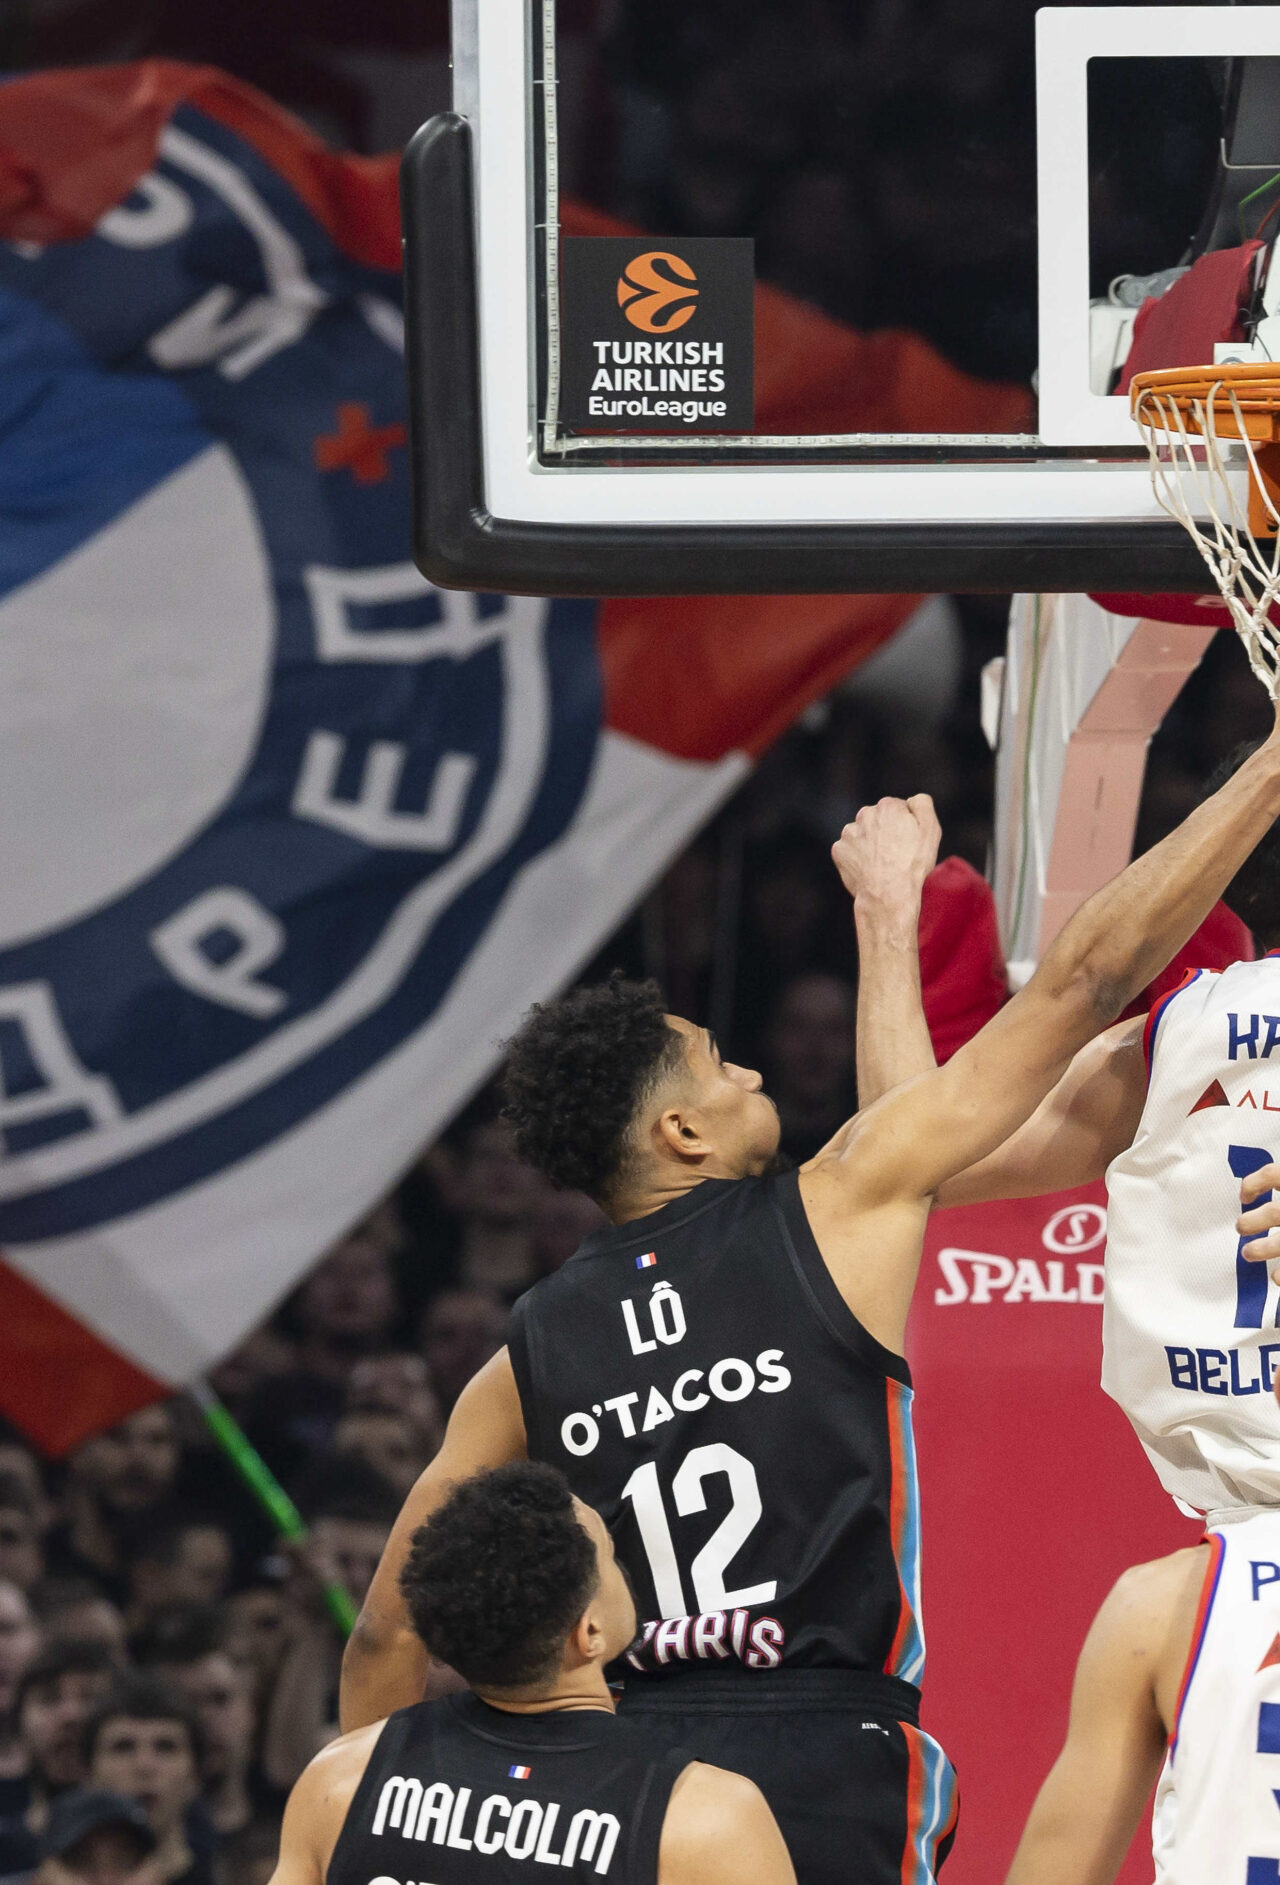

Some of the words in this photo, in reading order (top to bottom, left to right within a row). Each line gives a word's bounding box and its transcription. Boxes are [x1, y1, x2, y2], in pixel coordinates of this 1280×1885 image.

[591, 368, 725, 392] AIRLINES
[593, 341, 724, 365] TURKISH
[588, 396, 727, 422] EuroLeague
[621, 1281, 687, 1355] LÔ
[561, 1349, 791, 1456] O'TACOS
[621, 1443, 777, 1619] 12
[371, 1775, 620, 1875] MALCOLM
